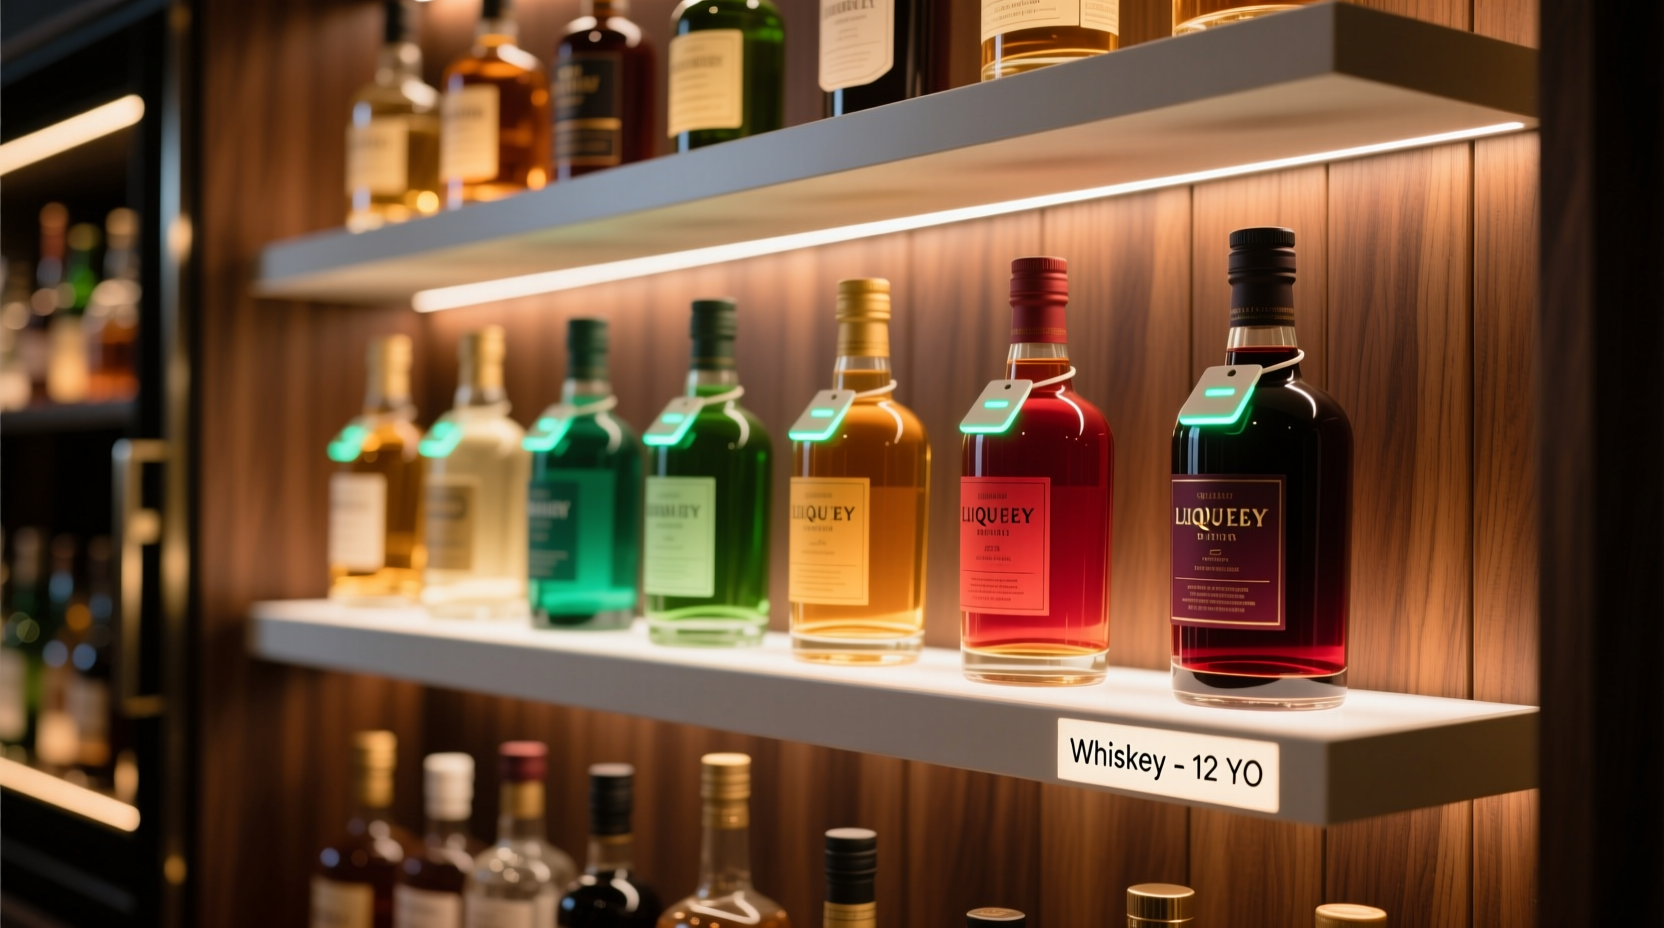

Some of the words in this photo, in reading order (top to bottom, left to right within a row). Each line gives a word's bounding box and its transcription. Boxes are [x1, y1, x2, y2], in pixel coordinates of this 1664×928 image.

[1070, 737, 1166, 781] Whiskey
[1192, 754, 1218, 782] 12
[1226, 757, 1263, 788] YO
